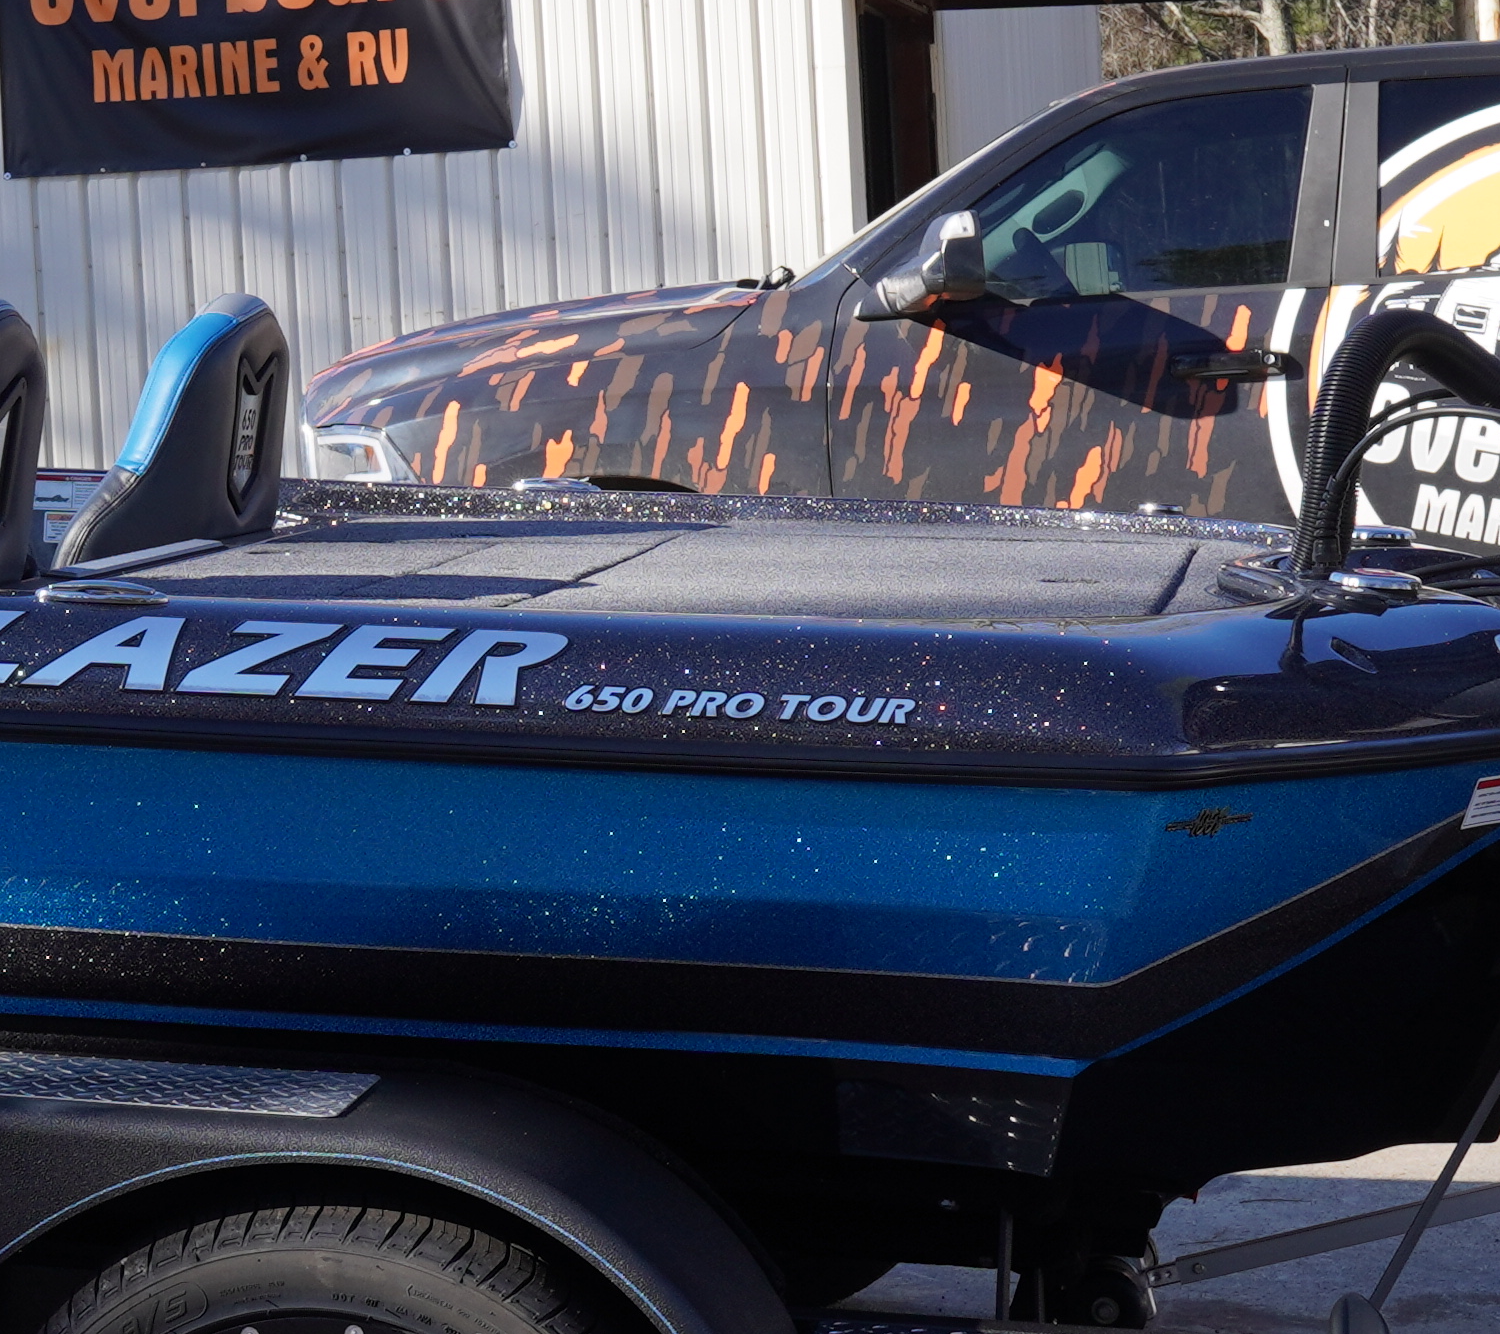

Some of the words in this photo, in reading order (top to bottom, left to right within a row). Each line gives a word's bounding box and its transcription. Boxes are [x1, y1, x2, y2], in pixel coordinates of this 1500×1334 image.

[92, 38, 280, 103] MARINE
[298, 34, 329, 90] &
[347, 28, 409, 87] RV
[242, 409, 257, 431] 650
[238, 435, 253, 452] PRO
[233, 454, 254, 471] TOUR
[564, 684, 654, 713] 650
[661, 688, 766, 718] PRO
[778, 693, 917, 725] TOUR
